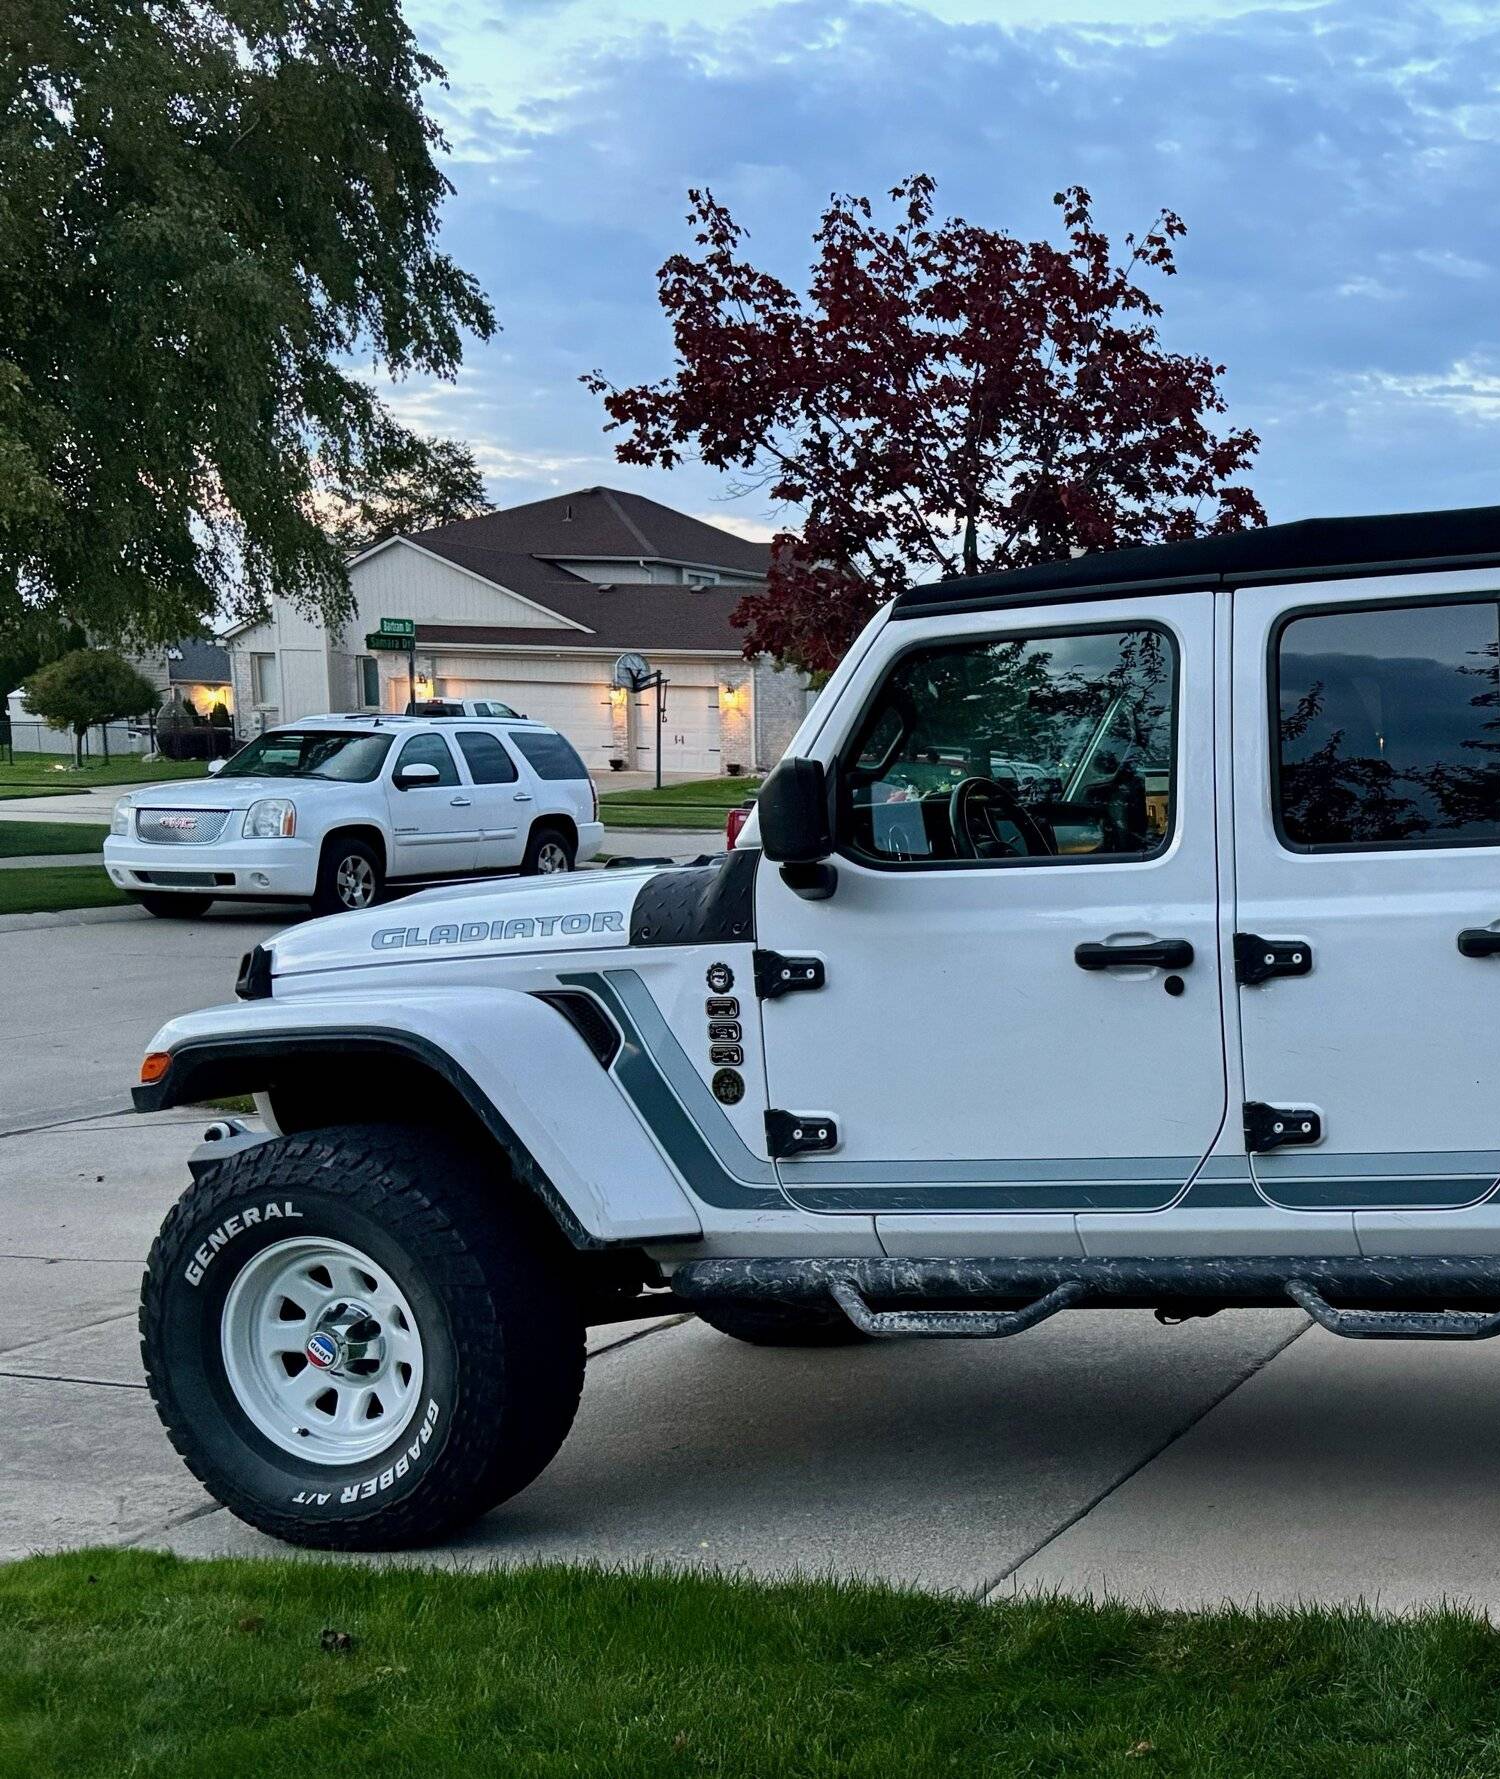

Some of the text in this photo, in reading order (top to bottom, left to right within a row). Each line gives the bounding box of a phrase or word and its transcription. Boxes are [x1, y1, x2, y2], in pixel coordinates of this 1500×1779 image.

[159, 817, 198, 829] GMC
[371, 911, 625, 950] GLADIATOR
[184, 1201, 304, 1287] GENERAL
[310, 1342, 331, 1361] Jeep
[292, 1398, 440, 1505] GRABBER A/T
